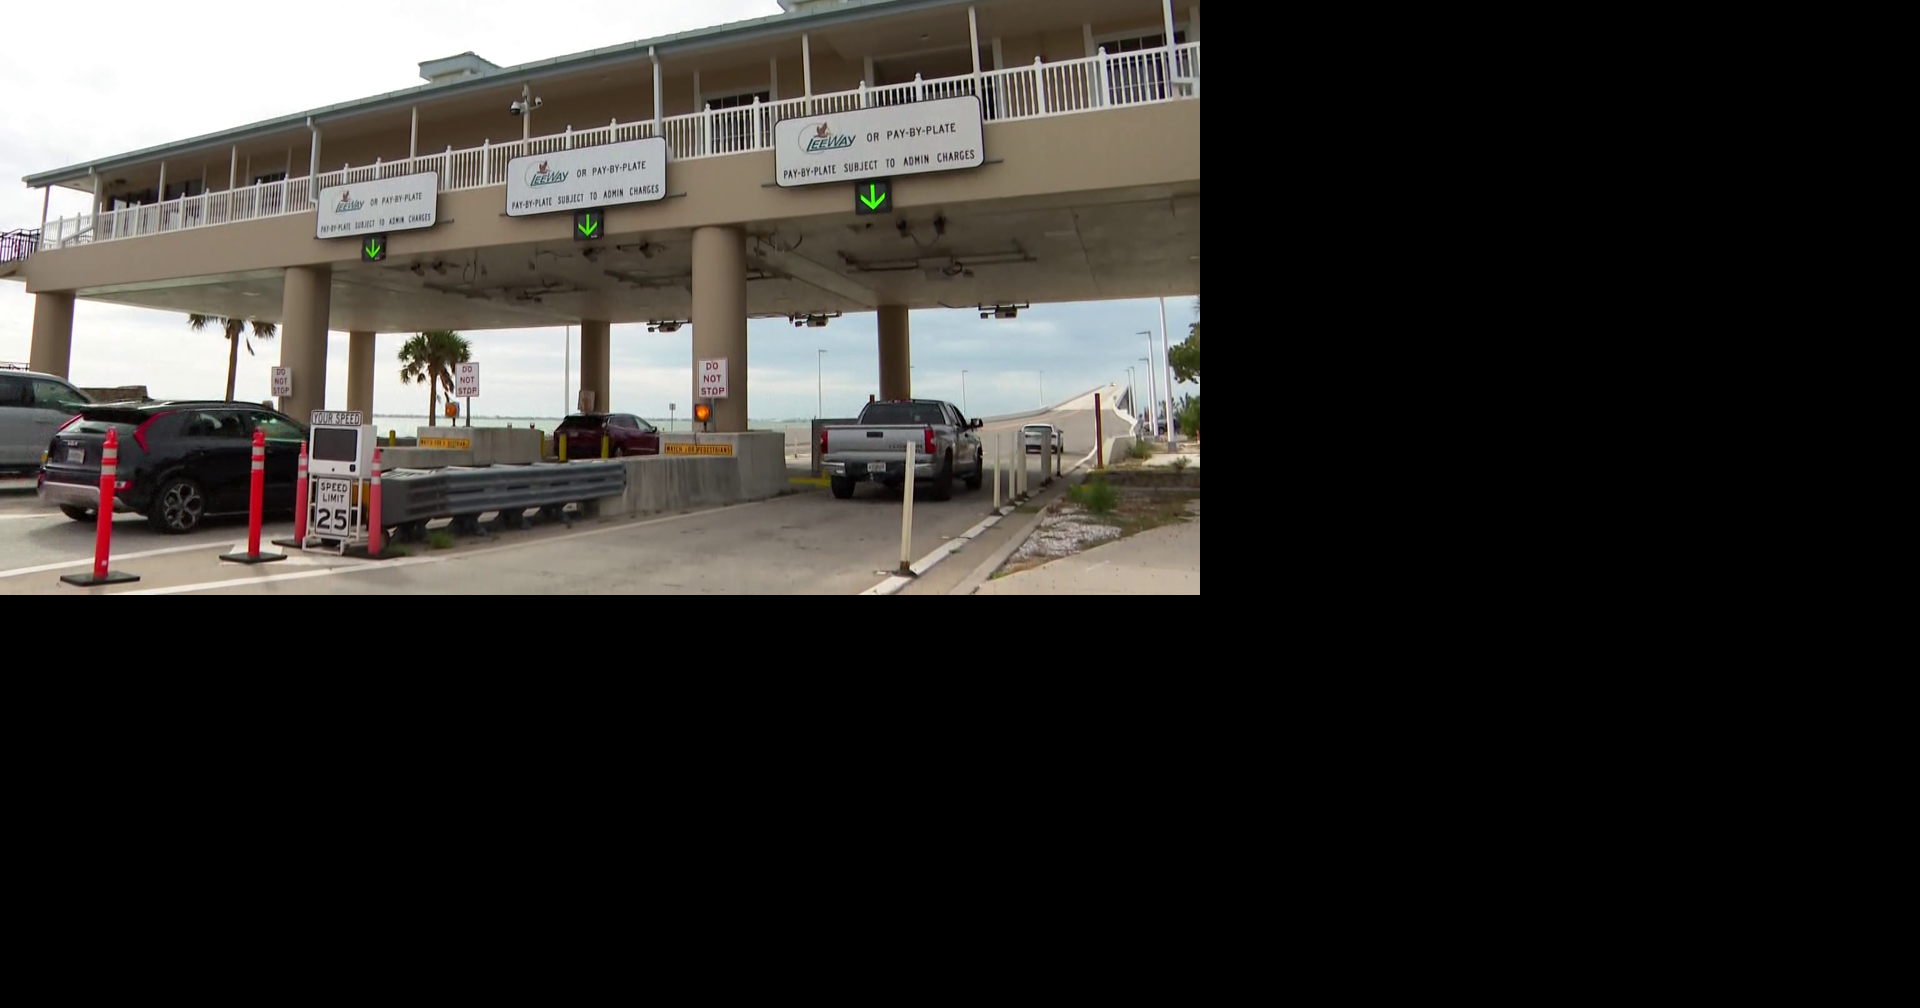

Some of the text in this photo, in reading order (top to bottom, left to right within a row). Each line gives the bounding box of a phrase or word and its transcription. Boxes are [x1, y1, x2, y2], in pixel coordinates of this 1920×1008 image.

[866, 133, 879, 142] OR
[887, 123, 956, 139] PAY-BY-PLATE
[783, 149, 975, 179] PAY-BY-PLATE SUBJECT TO ADMIN CHARGES
[576, 168, 587, 178] OR
[592, 161, 646, 177] PAY-BY-PLATE
[370, 199, 378, 207] OR
[382, 192, 422, 205] PAY-BY-PLATE
[512, 184, 659, 210] PAY-BY-PLATE SUBJECT TO ADMIN CHARGES
[320, 222, 351, 233] PAY-BY-PLATE
[355, 219, 375, 230] SUBJECT
[389, 216, 405, 225] ADMIN
[408, 213, 431, 223] CHARGES
[462, 365, 473, 373] DO
[706, 362, 718, 371] DO
[276, 368, 286, 376] DO
[274, 377, 287, 385] NOT
[460, 376, 475, 384] NOT
[703, 374, 721, 383] NOT
[273, 387, 290, 395] STOP
[458, 387, 477, 395] STOP
[701, 387, 725, 395] STOP
[313, 412, 360, 425] YOUR SPEED
[320, 482, 348, 493] SPEED
[322, 493, 345, 503] LIMIT
[317, 508, 348, 531] 25
